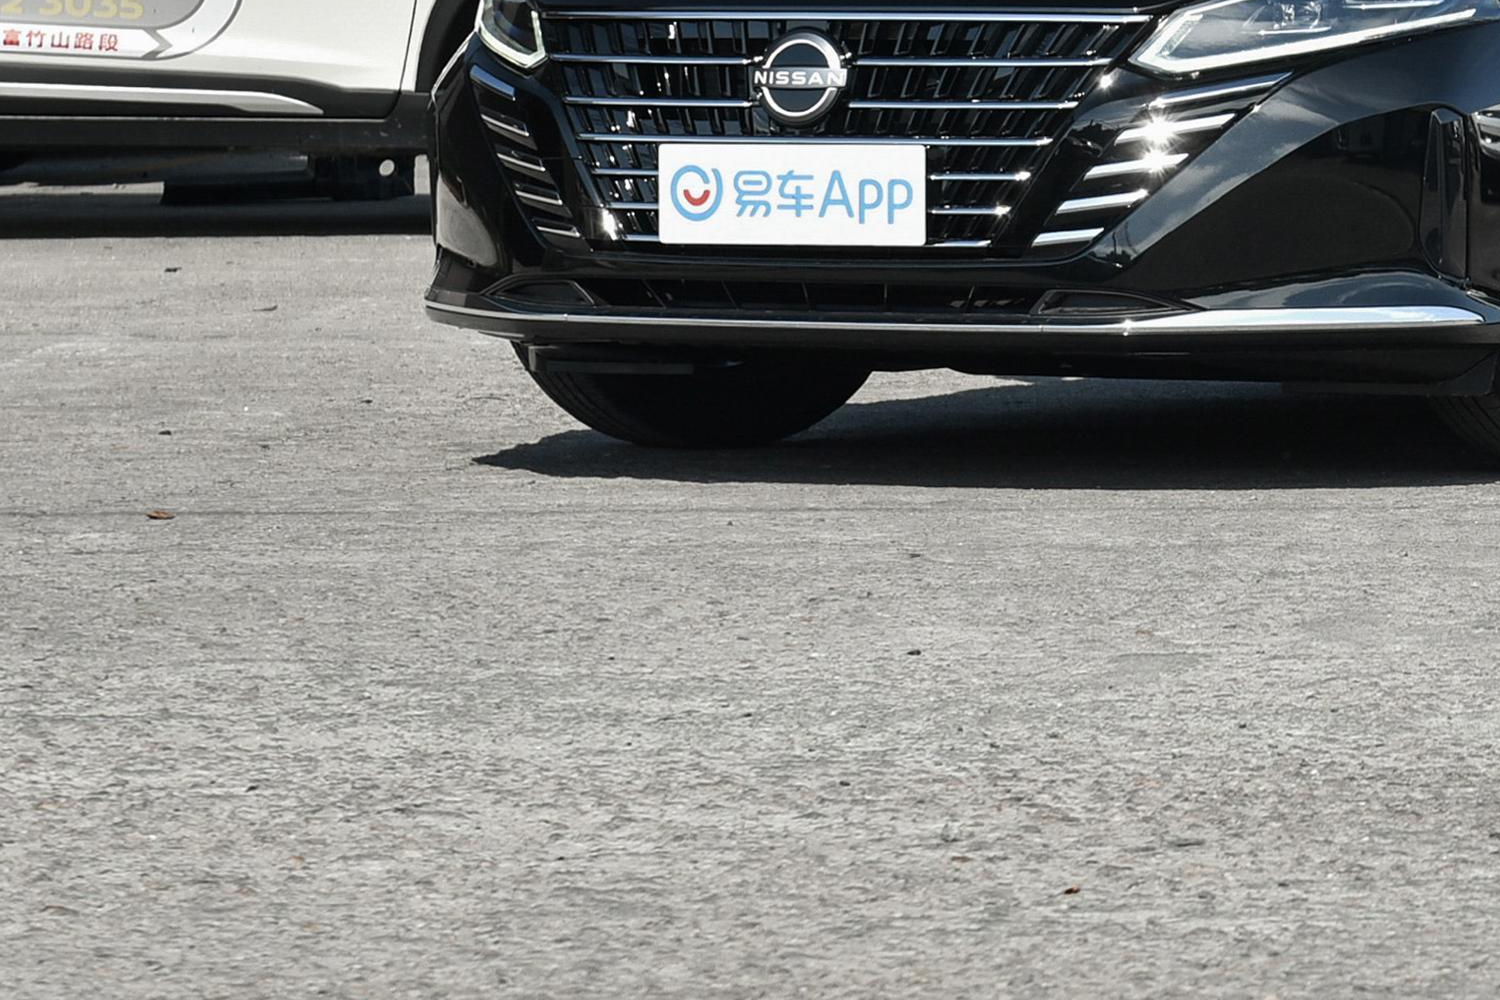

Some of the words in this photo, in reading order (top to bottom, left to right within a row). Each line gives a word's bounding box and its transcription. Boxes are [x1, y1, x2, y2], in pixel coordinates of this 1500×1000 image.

[2, 28, 119, 52] 富竹山路段
[754, 69, 846, 86] NISSAN
[733, 169, 914, 225] 易车App
